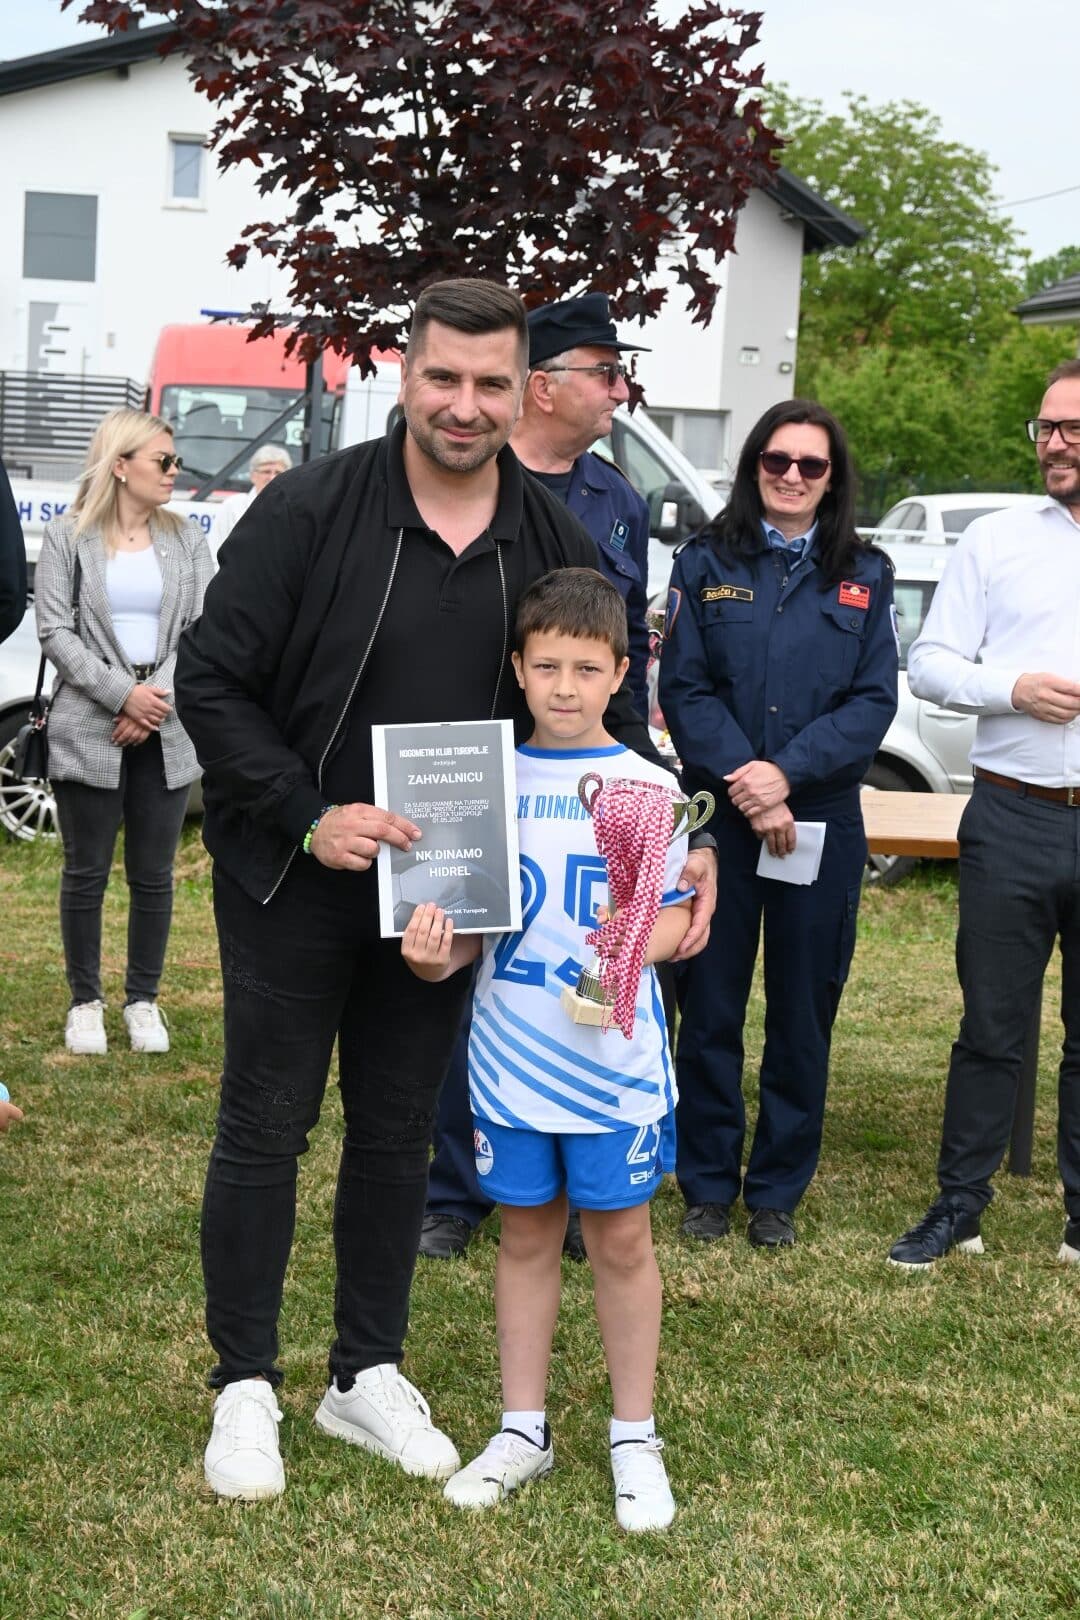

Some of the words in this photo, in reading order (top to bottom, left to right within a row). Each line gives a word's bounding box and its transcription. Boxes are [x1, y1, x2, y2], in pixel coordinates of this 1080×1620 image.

[399, 748, 434, 758] NOGOMETNI
[435, 746, 452, 756] KLUB
[454, 746, 488, 755] TUROPOLJE
[408, 772, 483, 785] ZAHVALNICU
[415, 850, 433, 862] NK
[435, 848, 483, 860] DINAMO
[429, 865, 472, 878] HIDREL
